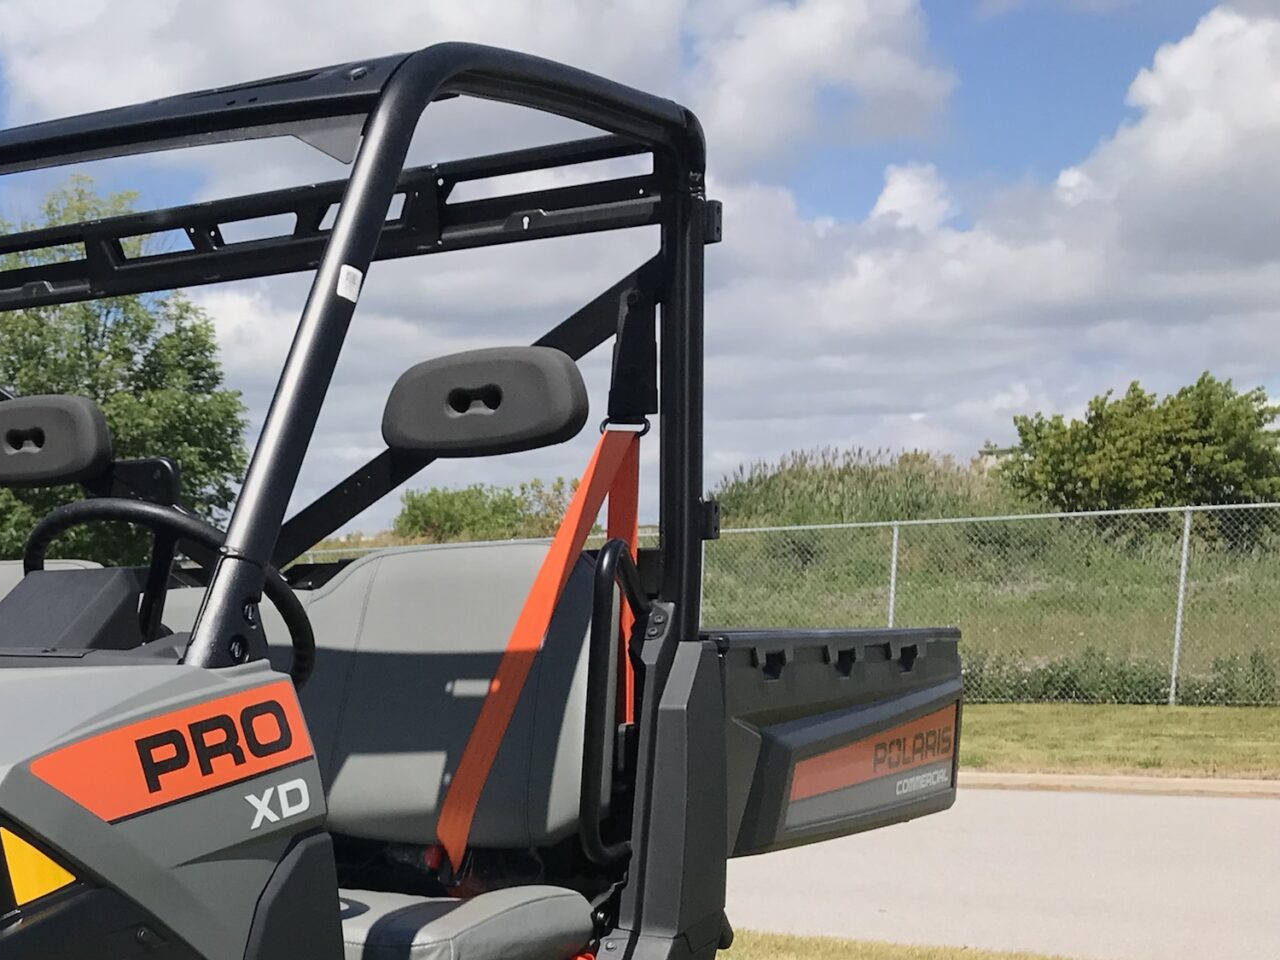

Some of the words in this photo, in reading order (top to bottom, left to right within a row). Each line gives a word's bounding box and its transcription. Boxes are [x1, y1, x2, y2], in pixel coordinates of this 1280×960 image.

[135, 700, 293, 794] PRO
[874, 727, 951, 773] POLARIS
[244, 778, 310, 830] XD
